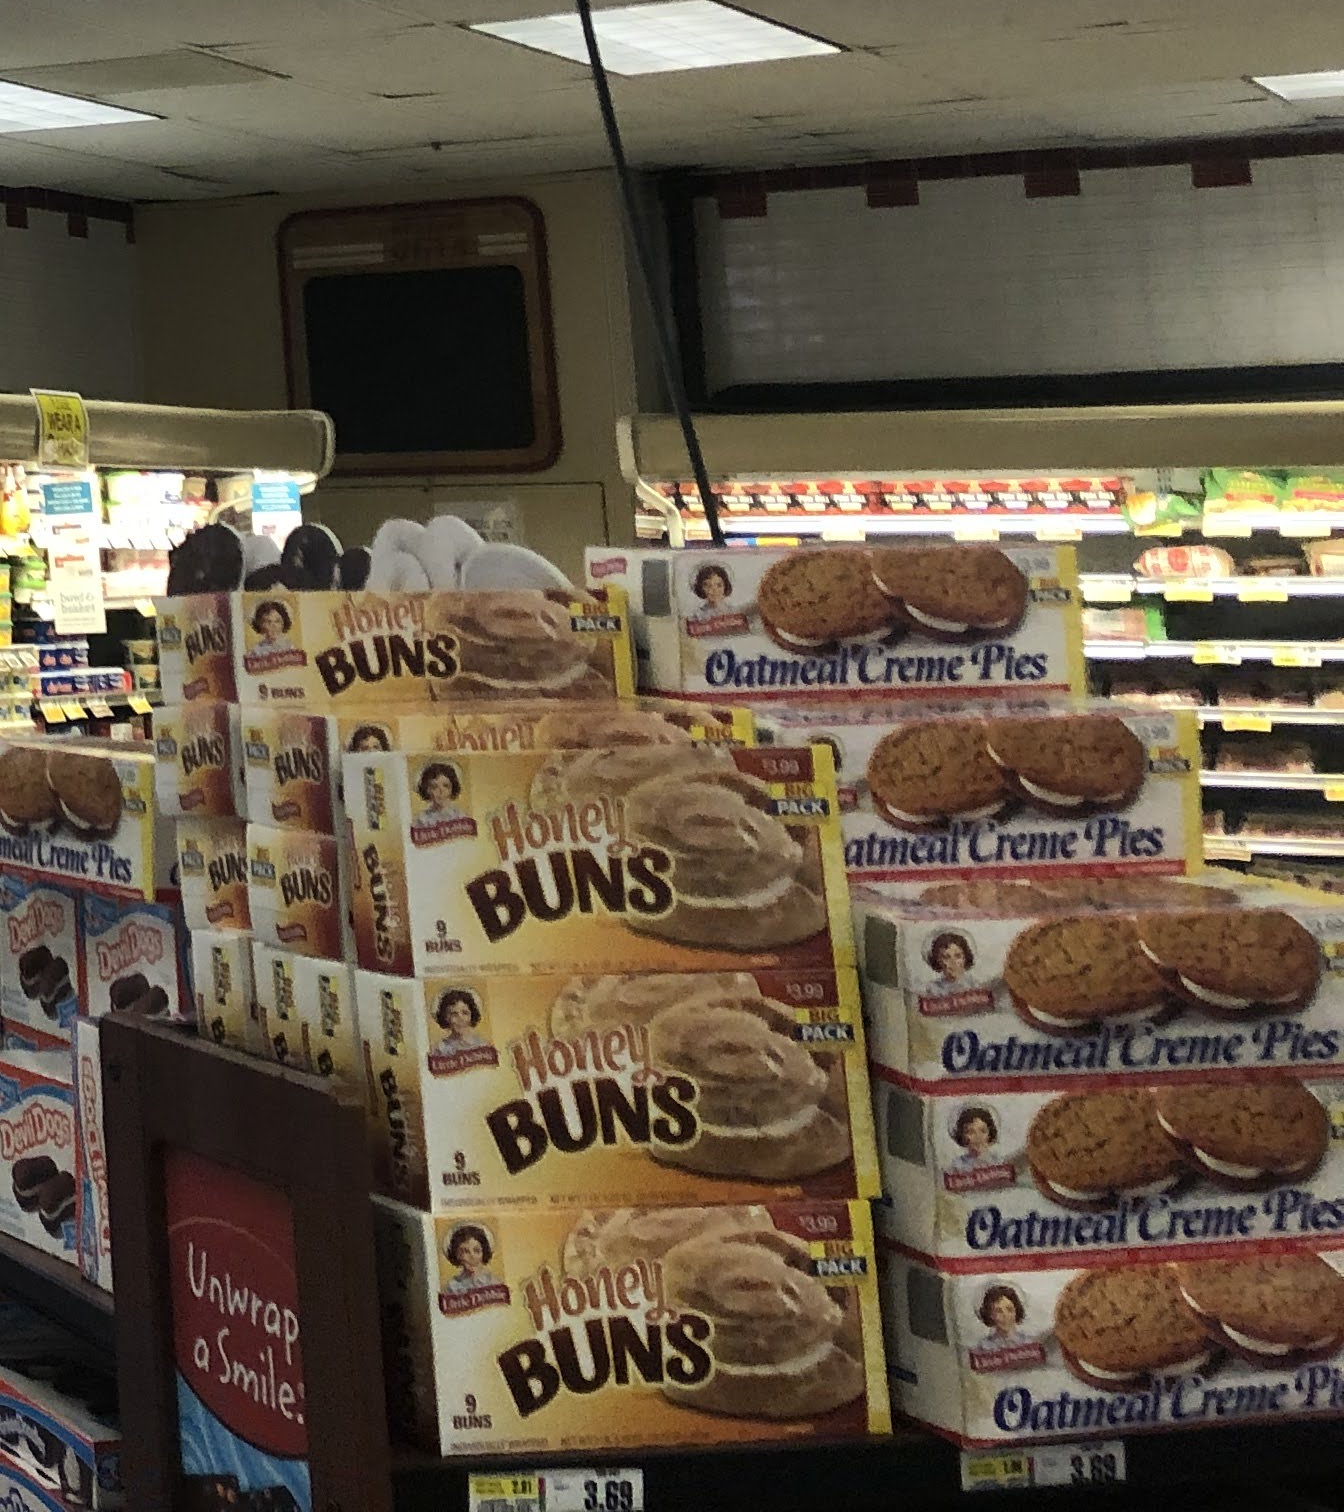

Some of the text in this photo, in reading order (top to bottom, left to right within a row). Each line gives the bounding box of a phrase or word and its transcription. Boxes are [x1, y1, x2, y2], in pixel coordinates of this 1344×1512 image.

[330, 592, 428, 642] Honey
[574, 617, 619, 632] PACK
[185, 620, 227, 664] BUNS
[314, 631, 458, 697] BUNS
[705, 644, 1048, 687] Oatmeal Creme Pies
[181, 734, 224, 776] BUNS
[274, 745, 324, 787] BUNS
[489, 794, 639, 862] Honey
[776, 799, 826, 817] PACK
[36, 836, 89, 874] Creme
[91, 841, 133, 884] Pies
[845, 816, 1164, 868] atmeal Creme Pies
[280, 868, 332, 907] BUNS
[362, 843, 395, 963] BUNS
[465, 844, 675, 944] BUNS
[424, 938, 463, 954] BUNS
[512, 1022, 664, 1088] Honey
[801, 1024, 850, 1042] PACK
[941, 1019, 1340, 1074] Oatmeal Creme Pies
[0, 1101, 73, 1161] Devil Dogs
[485, 1075, 698, 1176] BUNS
[441, 1171, 482, 1187] BUNS
[454, 1149, 466, 1171] 9
[965, 1188, 1344, 1252] Oatmeal Creme Pies
[816, 1258, 864, 1276] PACK
[187, 1241, 300, 1366] Unwrap
[524, 1258, 678, 1330] Honey
[193, 1337, 210, 1373] a
[497, 1312, 712, 1419] BUNS
[464, 1393, 478, 1414] 9
[993, 1362, 1344, 1433] Oatmeal Creme Pi
[451, 1414, 492, 1431] BUNS
[583, 1479, 634, 1512] 3.69
